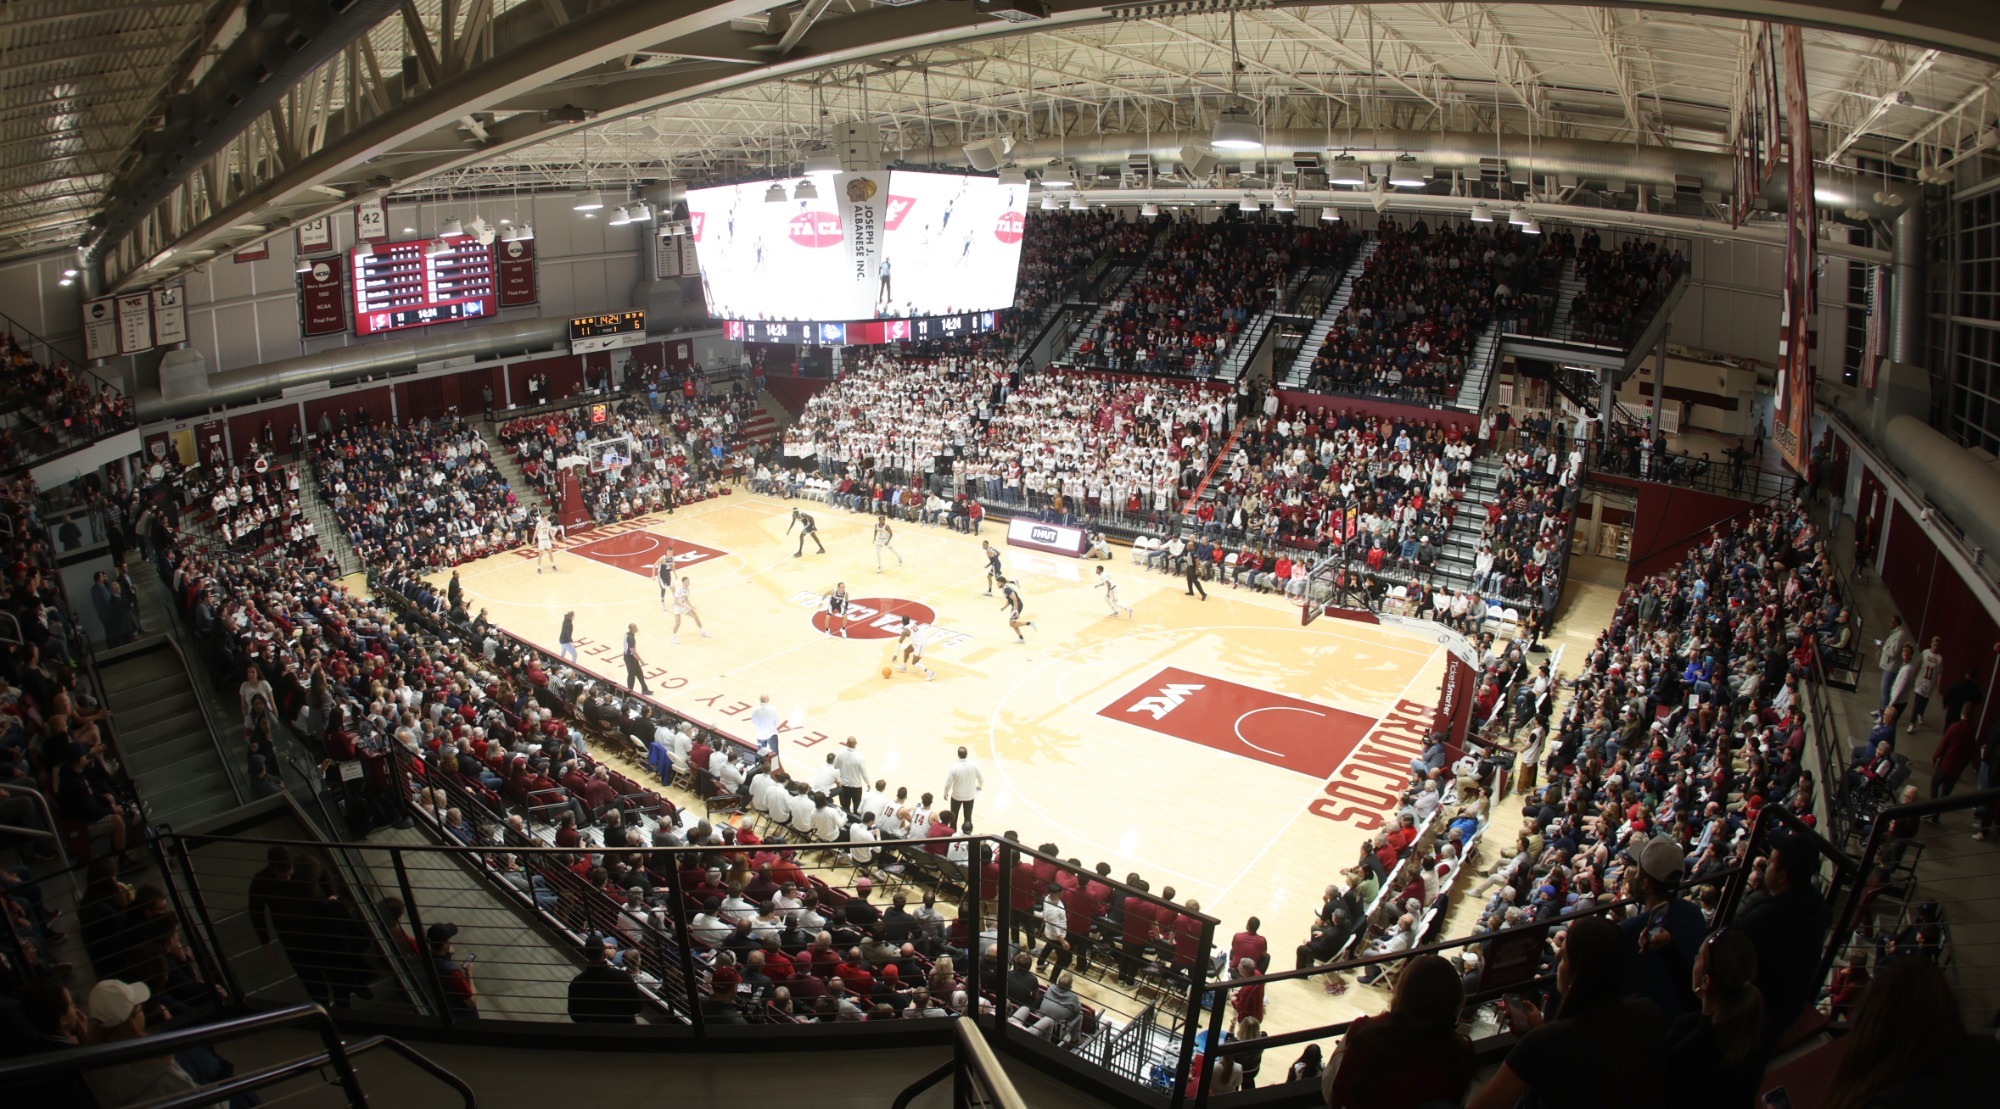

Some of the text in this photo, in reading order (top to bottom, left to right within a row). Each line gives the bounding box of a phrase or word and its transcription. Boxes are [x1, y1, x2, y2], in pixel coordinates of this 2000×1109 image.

[363, 212, 380, 224] 42
[865, 205, 874, 244] JOSEPH
[854, 205, 865, 281] ALBANESE INC.
[866, 248, 874, 256] J.
[397, 313, 404, 321] 11
[600, 315, 619, 325] 14:24
[581, 327, 590, 335] 11
[634, 320, 640, 329] 6
[747, 324, 810, 338] 11 14:24 6
[918, 321, 927, 334] 11
[942, 317, 961, 330] 14:24
[571, 637, 688, 690] CETER
[1924, 666, 1934, 680] 11
[1443, 661, 1459, 716] TicketSmarter
[694, 693, 850, 748] EAEY
[884, 806, 894, 817] 10
[914, 813, 925, 826] 14
